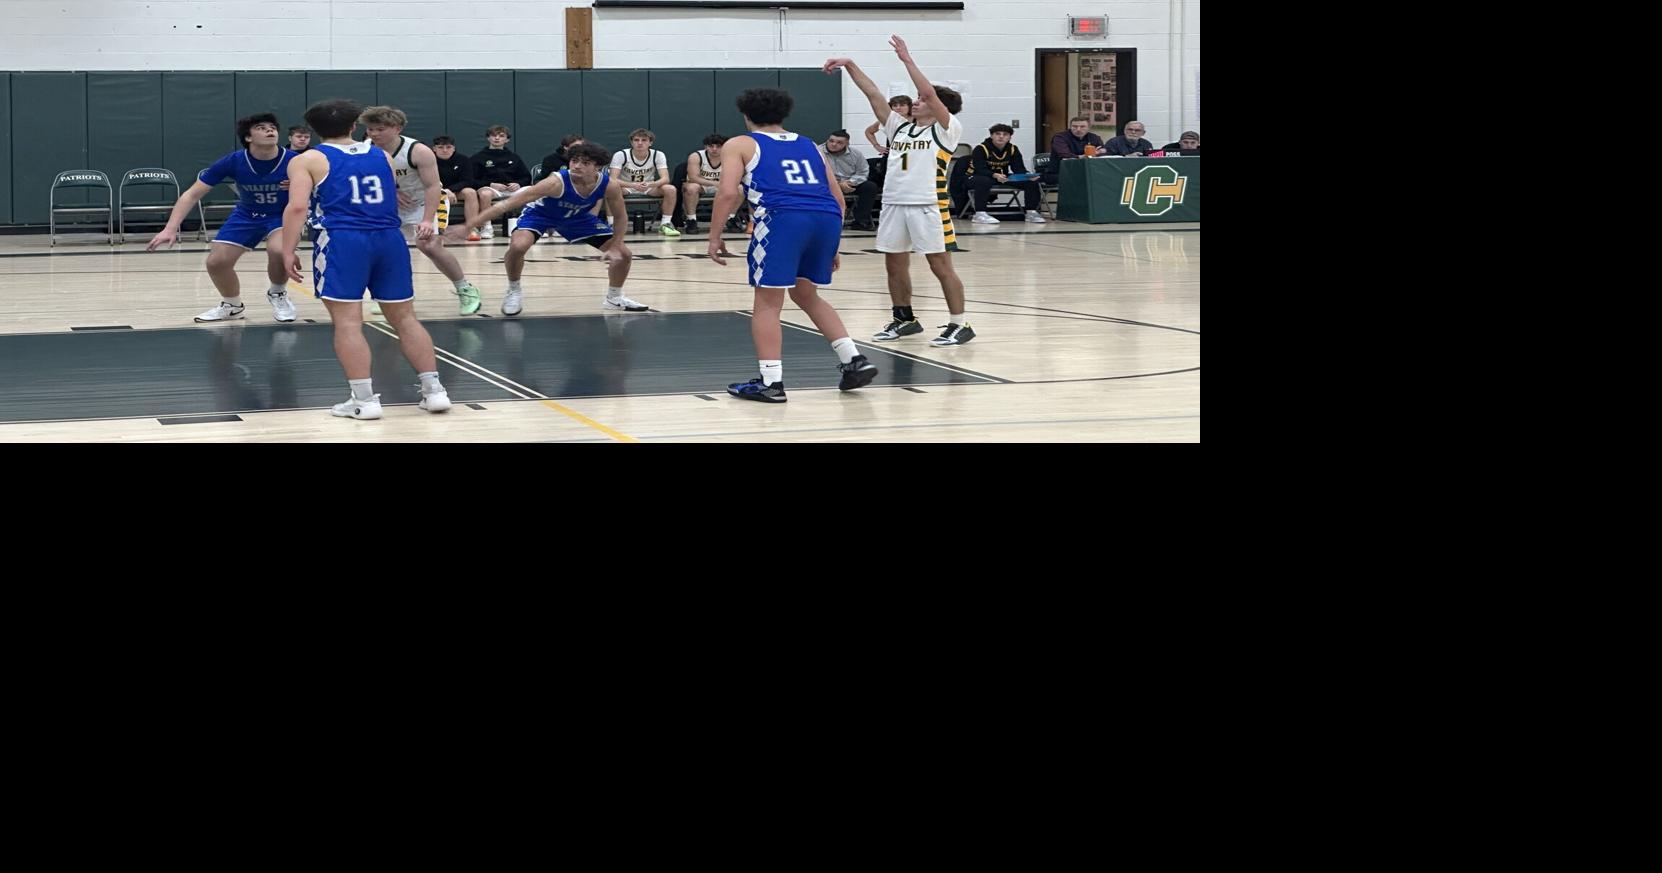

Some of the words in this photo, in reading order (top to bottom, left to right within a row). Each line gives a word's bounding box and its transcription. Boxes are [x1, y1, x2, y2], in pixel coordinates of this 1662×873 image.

[901, 153, 908, 171] 1
[60, 174, 102, 182] PATRIOTS
[128, 172, 170, 180] PATRIOTS
[781, 159, 820, 184] 21
[349, 175, 384, 204] 13
[254, 192, 278, 204] 35
